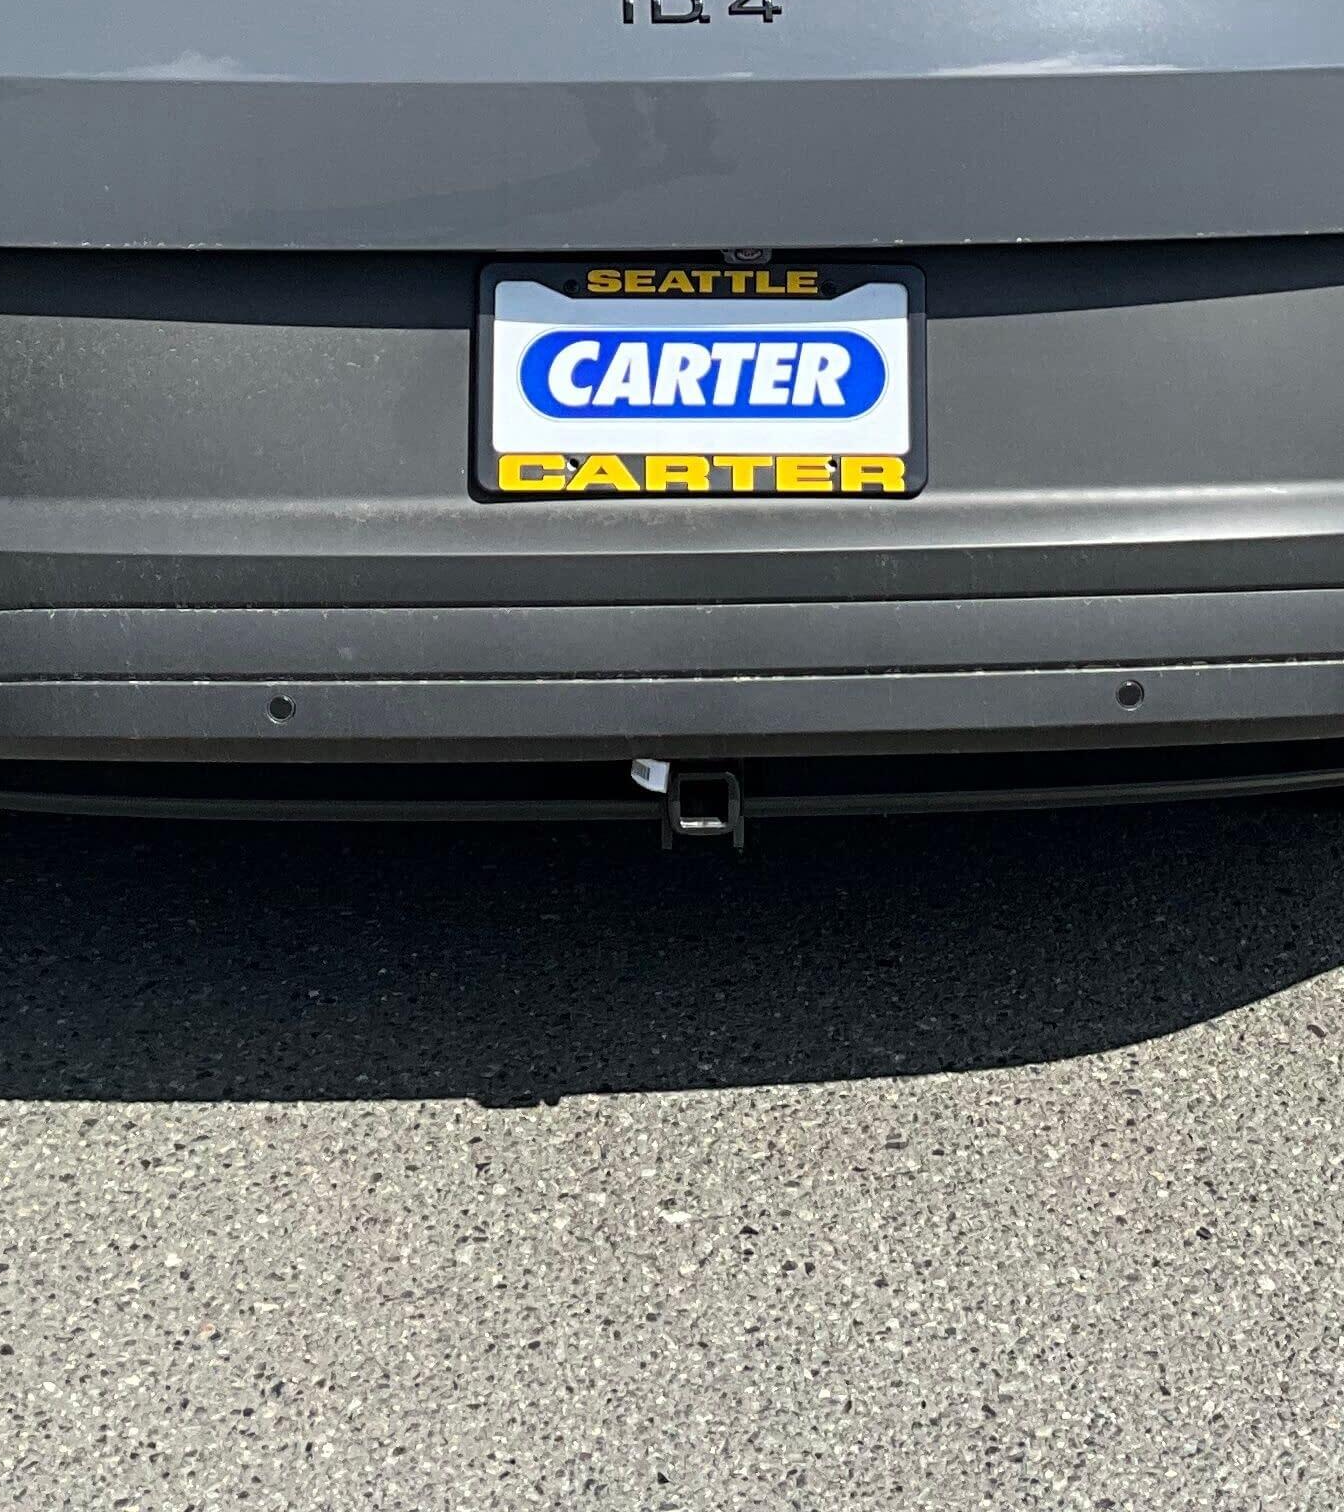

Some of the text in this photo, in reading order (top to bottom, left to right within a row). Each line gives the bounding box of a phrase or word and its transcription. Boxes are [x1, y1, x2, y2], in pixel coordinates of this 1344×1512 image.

[586, 269, 820, 294] SEATTLE
[547, 340, 852, 408] CARTER
[497, 454, 908, 493] CARTER
